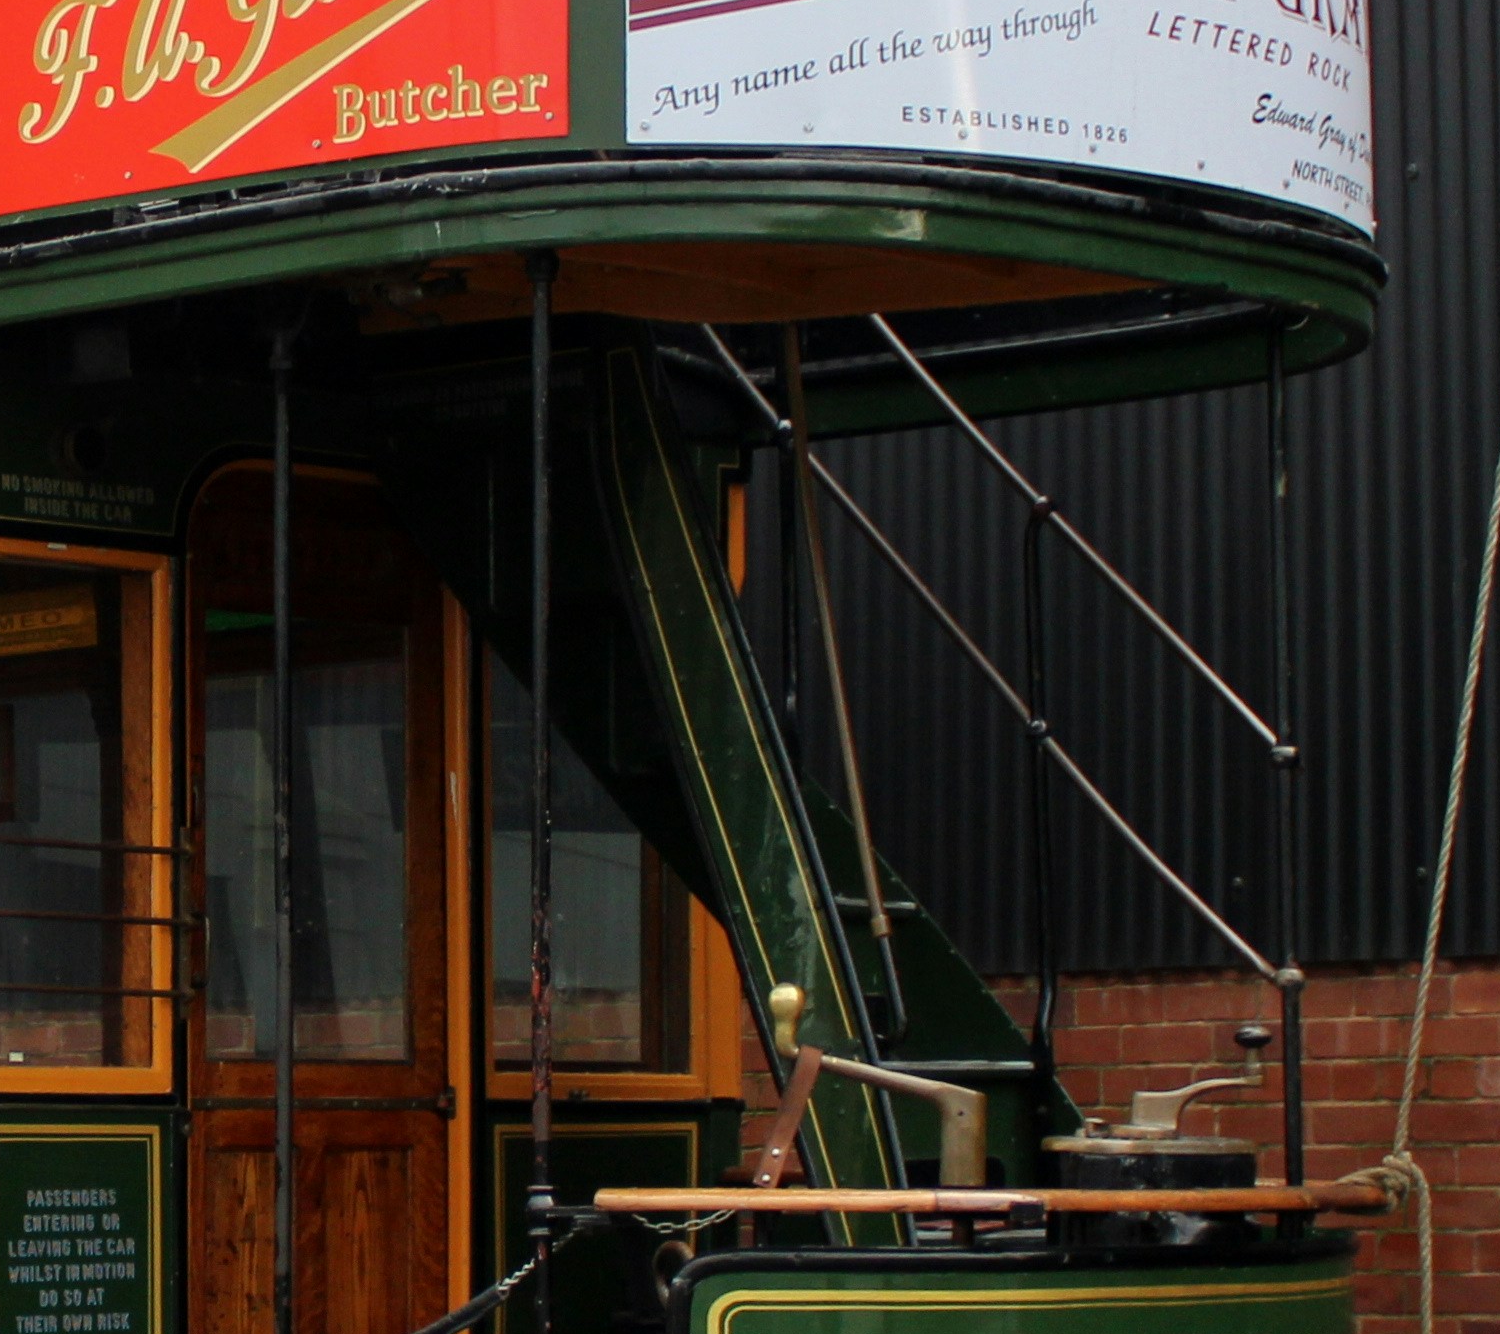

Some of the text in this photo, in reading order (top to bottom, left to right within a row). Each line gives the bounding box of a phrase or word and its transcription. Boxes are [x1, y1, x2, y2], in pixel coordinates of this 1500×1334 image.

[1147, 11, 1351, 92] LETTERED ROCK
[652, 81, 721, 115] Any
[731, 60, 818, 96] name
[829, 39, 869, 75] all
[877, 30, 923, 64] the
[932, 24, 992, 58] way
[333, 65, 548, 144] Butcher
[901, 105, 1128, 144] ESTABLISHED 1826
[1252, 93, 1317, 134] Edward
[1318, 114, 1346, 156] Gray
[1292, 158, 1333, 189] NORTH
[26, 1188, 117, 1207] PASSENGERS
[23, 1212, 120, 1232] ENTERING OR
[8, 1237, 135, 1258] LEAVING THE CAR
[8, 1262, 135, 1283] WHILST IN MOTION
[39, 1287, 105, 1307] DO SO AT
[15, 1312, 130, 1334] THEIR OWN RISK
